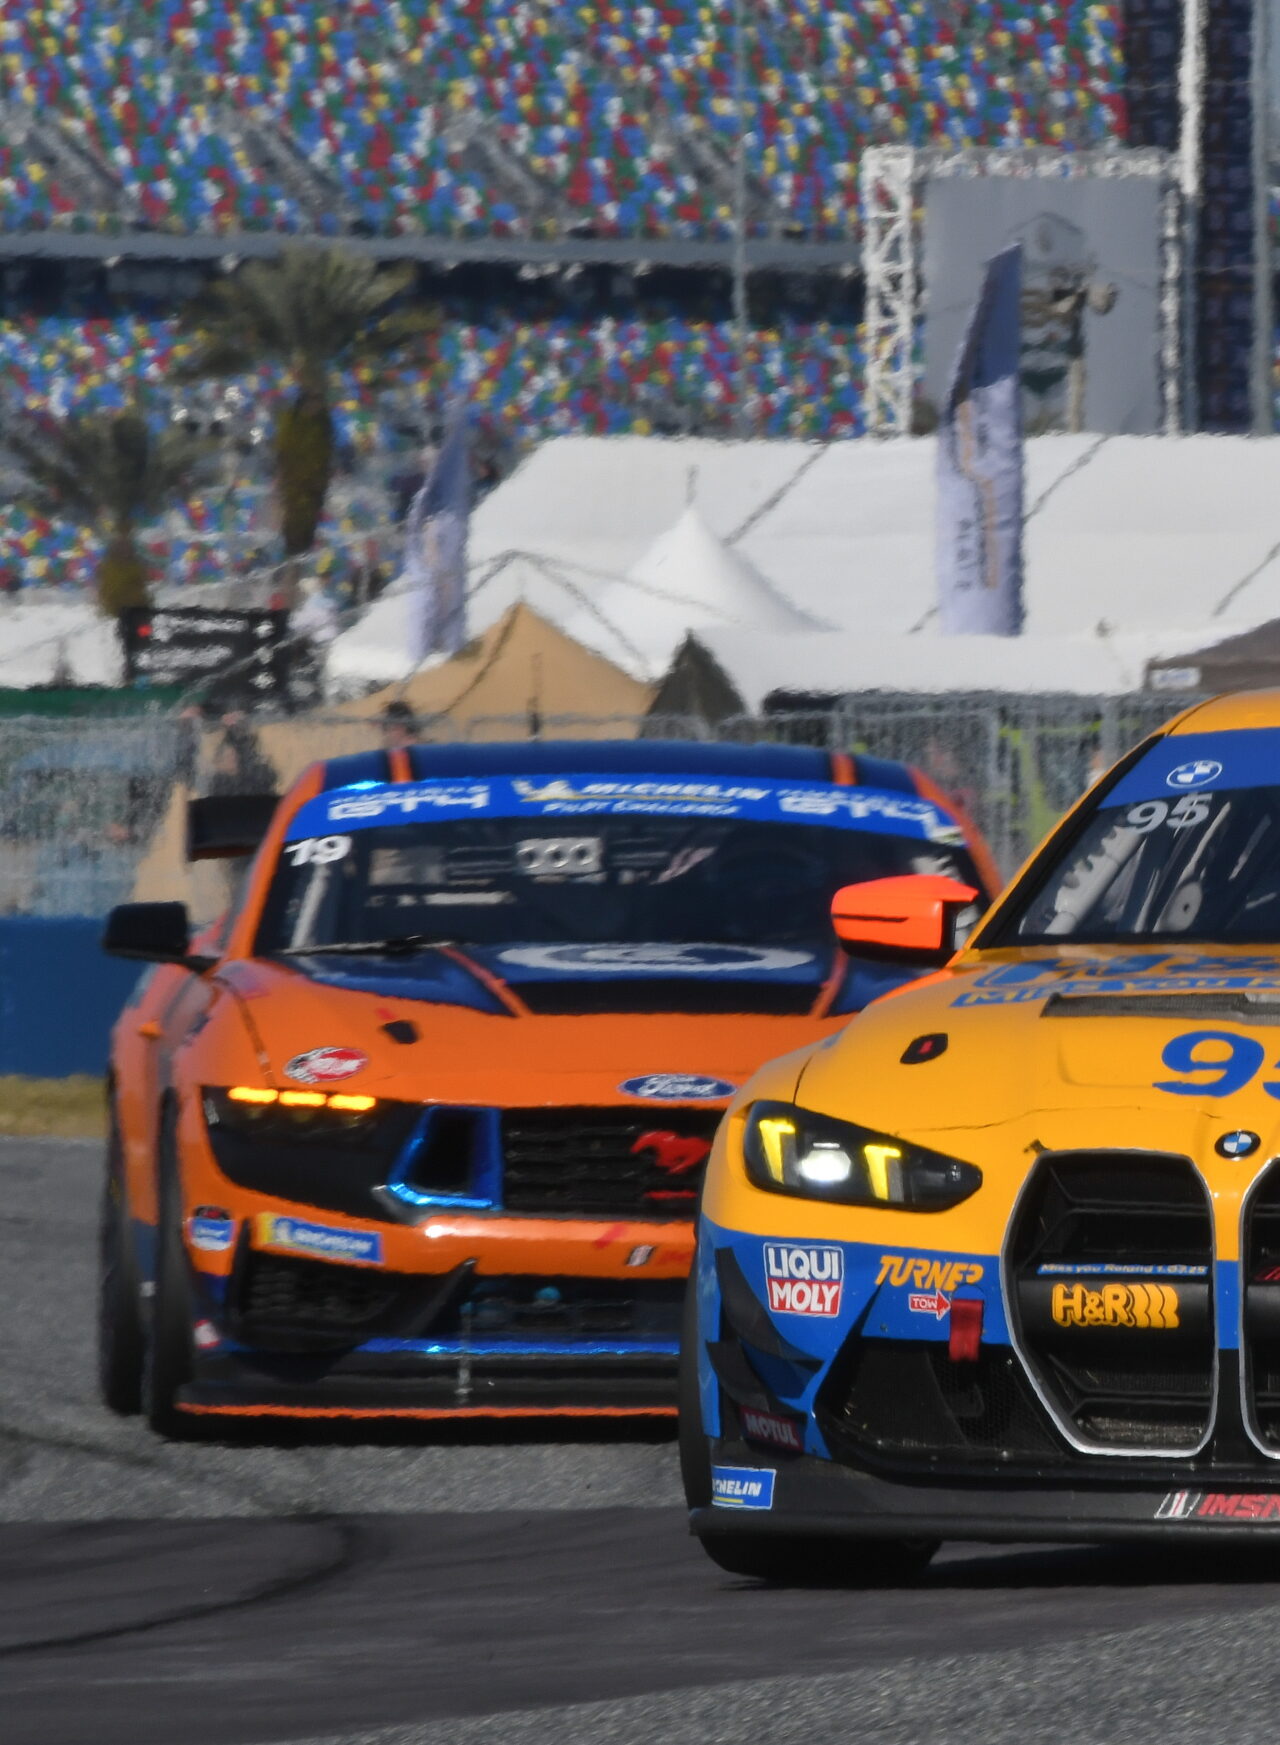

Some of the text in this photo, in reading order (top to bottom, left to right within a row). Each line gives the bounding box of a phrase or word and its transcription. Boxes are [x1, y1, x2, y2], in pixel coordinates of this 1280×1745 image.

[580, 783, 771, 800] MICHELIN
[1127, 793, 1213, 834] 95
[284, 835, 352, 867] 19
[768, 1247, 840, 1281] LIQUI
[770, 1280, 841, 1313] MOLY
[912, 1296, 938, 1310] TOW
[1052, 1282, 1135, 1328] H&R
[744, 1412, 800, 1447] MOTUL
